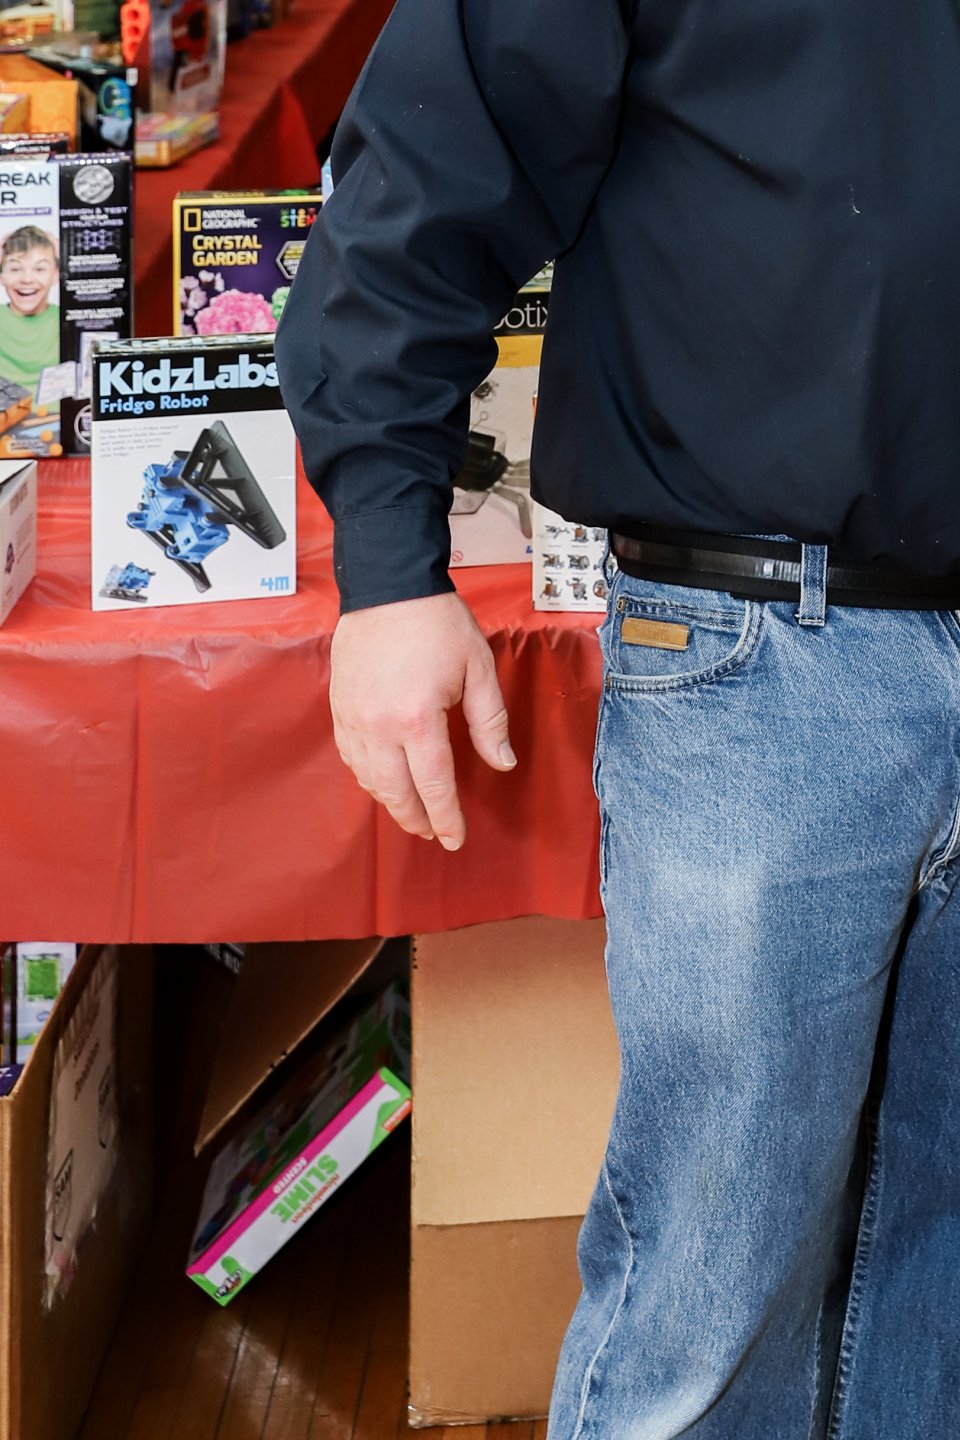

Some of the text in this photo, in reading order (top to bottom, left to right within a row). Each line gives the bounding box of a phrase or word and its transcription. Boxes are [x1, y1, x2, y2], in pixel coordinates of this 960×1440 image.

[202, 208, 246, 220] NATIONAL
[202, 218, 258, 230] GEOGRAPHIC
[192, 234, 263, 251] CRYSTAL
[192, 250, 258, 267] GARDEN
[99, 353, 280, 397] KidzLabs
[100, 393, 209, 415] Fridge Robot
[260, 575, 289, 592] 4M
[272, 1157, 308, 1194] SCENTED
[270, 1154, 338, 1224] SLIME
